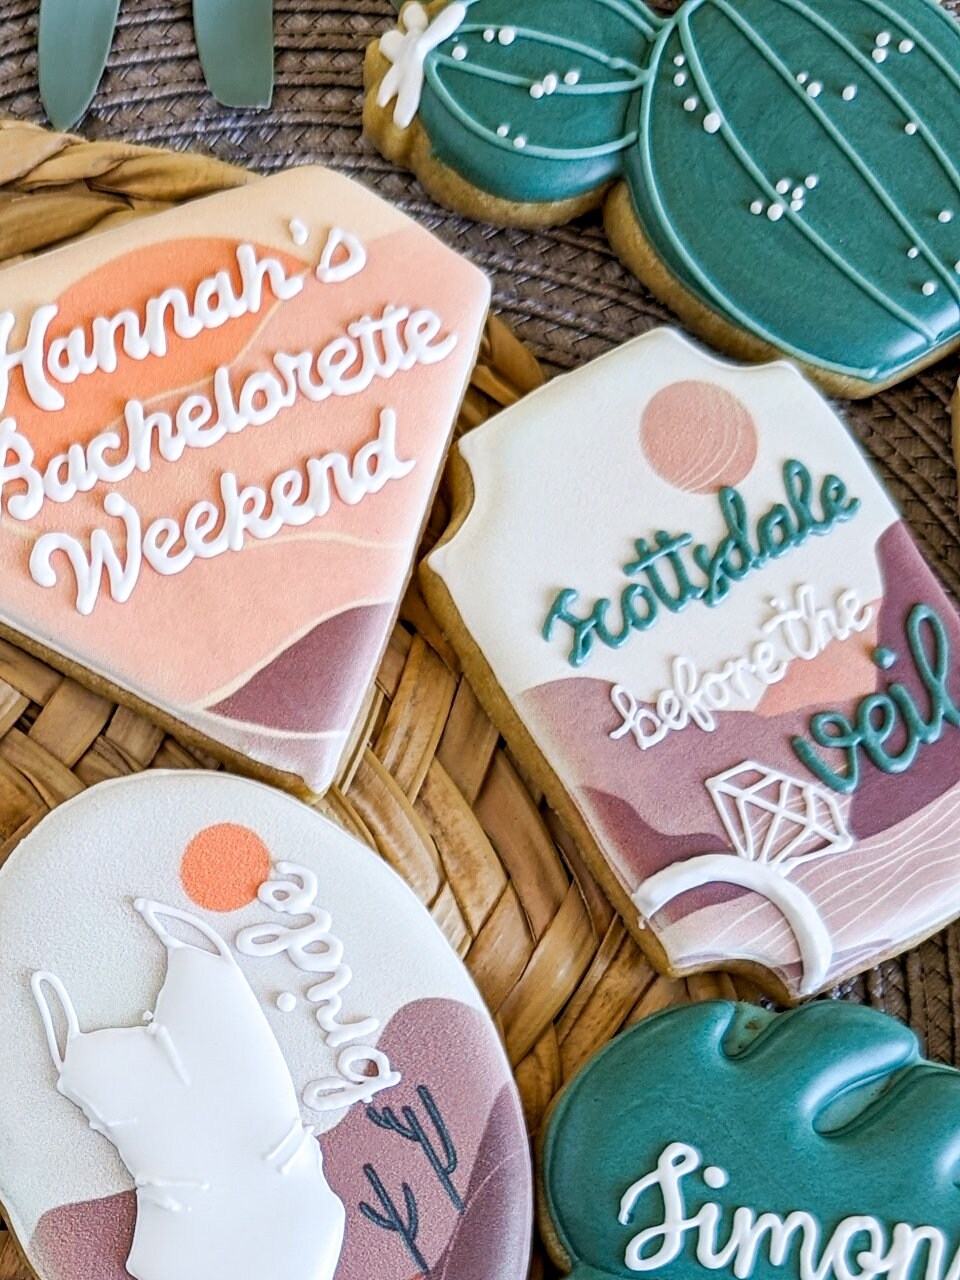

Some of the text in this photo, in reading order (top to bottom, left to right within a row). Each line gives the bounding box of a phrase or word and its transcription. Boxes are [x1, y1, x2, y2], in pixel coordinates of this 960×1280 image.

[30, 408, 416, 615] Weekend
[609, 584, 874, 750] before the
[793, 604, 960, 795] veil
[235, 861, 402, 1112] bride
